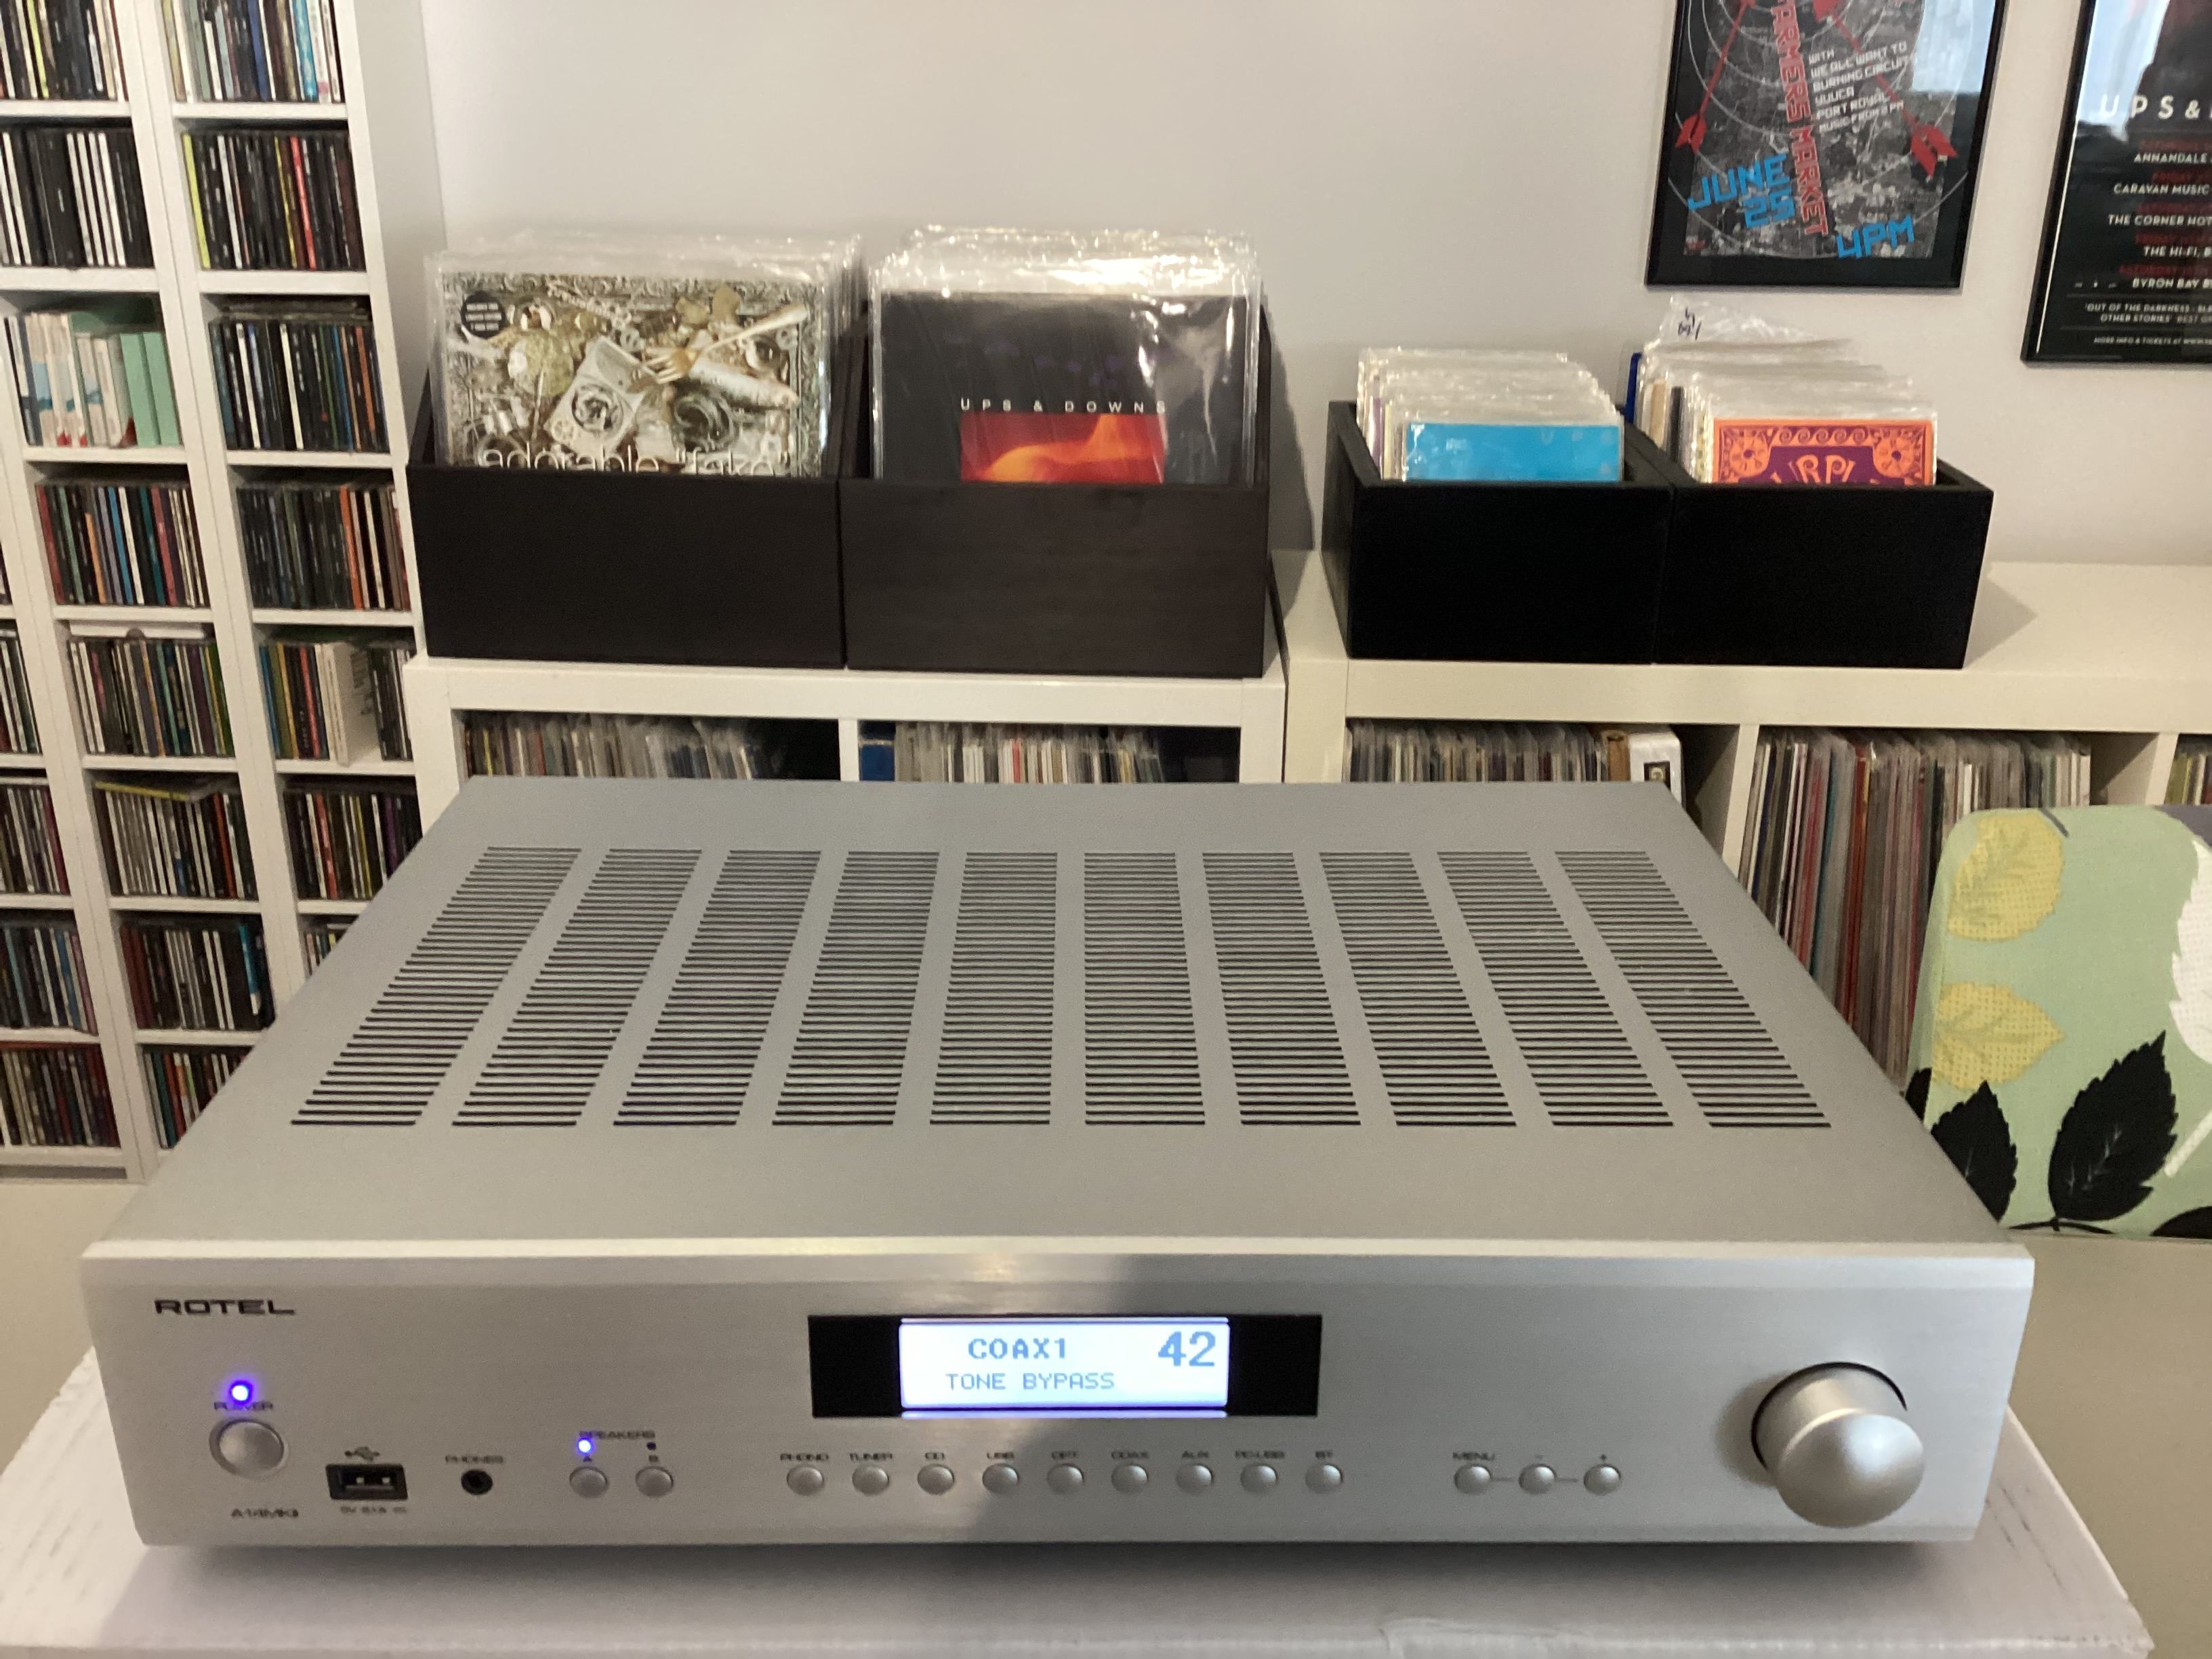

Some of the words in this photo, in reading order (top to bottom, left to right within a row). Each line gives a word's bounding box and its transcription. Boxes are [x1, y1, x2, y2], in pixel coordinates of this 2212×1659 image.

[1771, 0, 1811, 123] ARMERS
[1809, 49, 1835, 64] WITH
[2185, 100, 2201, 120] &
[2134, 151, 2208, 164] ANNANDALE
[1687, 153, 1790, 210] JUNE
[1790, 125, 1829, 237] MARKET
[2113, 182, 2169, 195] CARAVAN
[2171, 184, 2211, 195] MUSIC
[1742, 188, 1795, 228] 25
[2108, 213, 2131, 226] THE
[2134, 215, 2184, 226] CORNER
[1836, 213, 1914, 260] 4PM
[2144, 245, 2167, 257] THE
[2132, 277, 2174, 289] BYRON
[2176, 278, 2200, 289] BAY
[2108, 303, 2121, 312] OF
[154, 1300, 295, 1315] ROTEL
[968, 1338, 1066, 1359] COAX1
[1158, 1330, 1216, 1368] 42
[946, 1373, 1006, 1390] TONE
[1023, 1373, 1115, 1390] BYPASS
[780, 1452, 829, 1461] PHONO
[924, 1452, 945, 1460] CD
